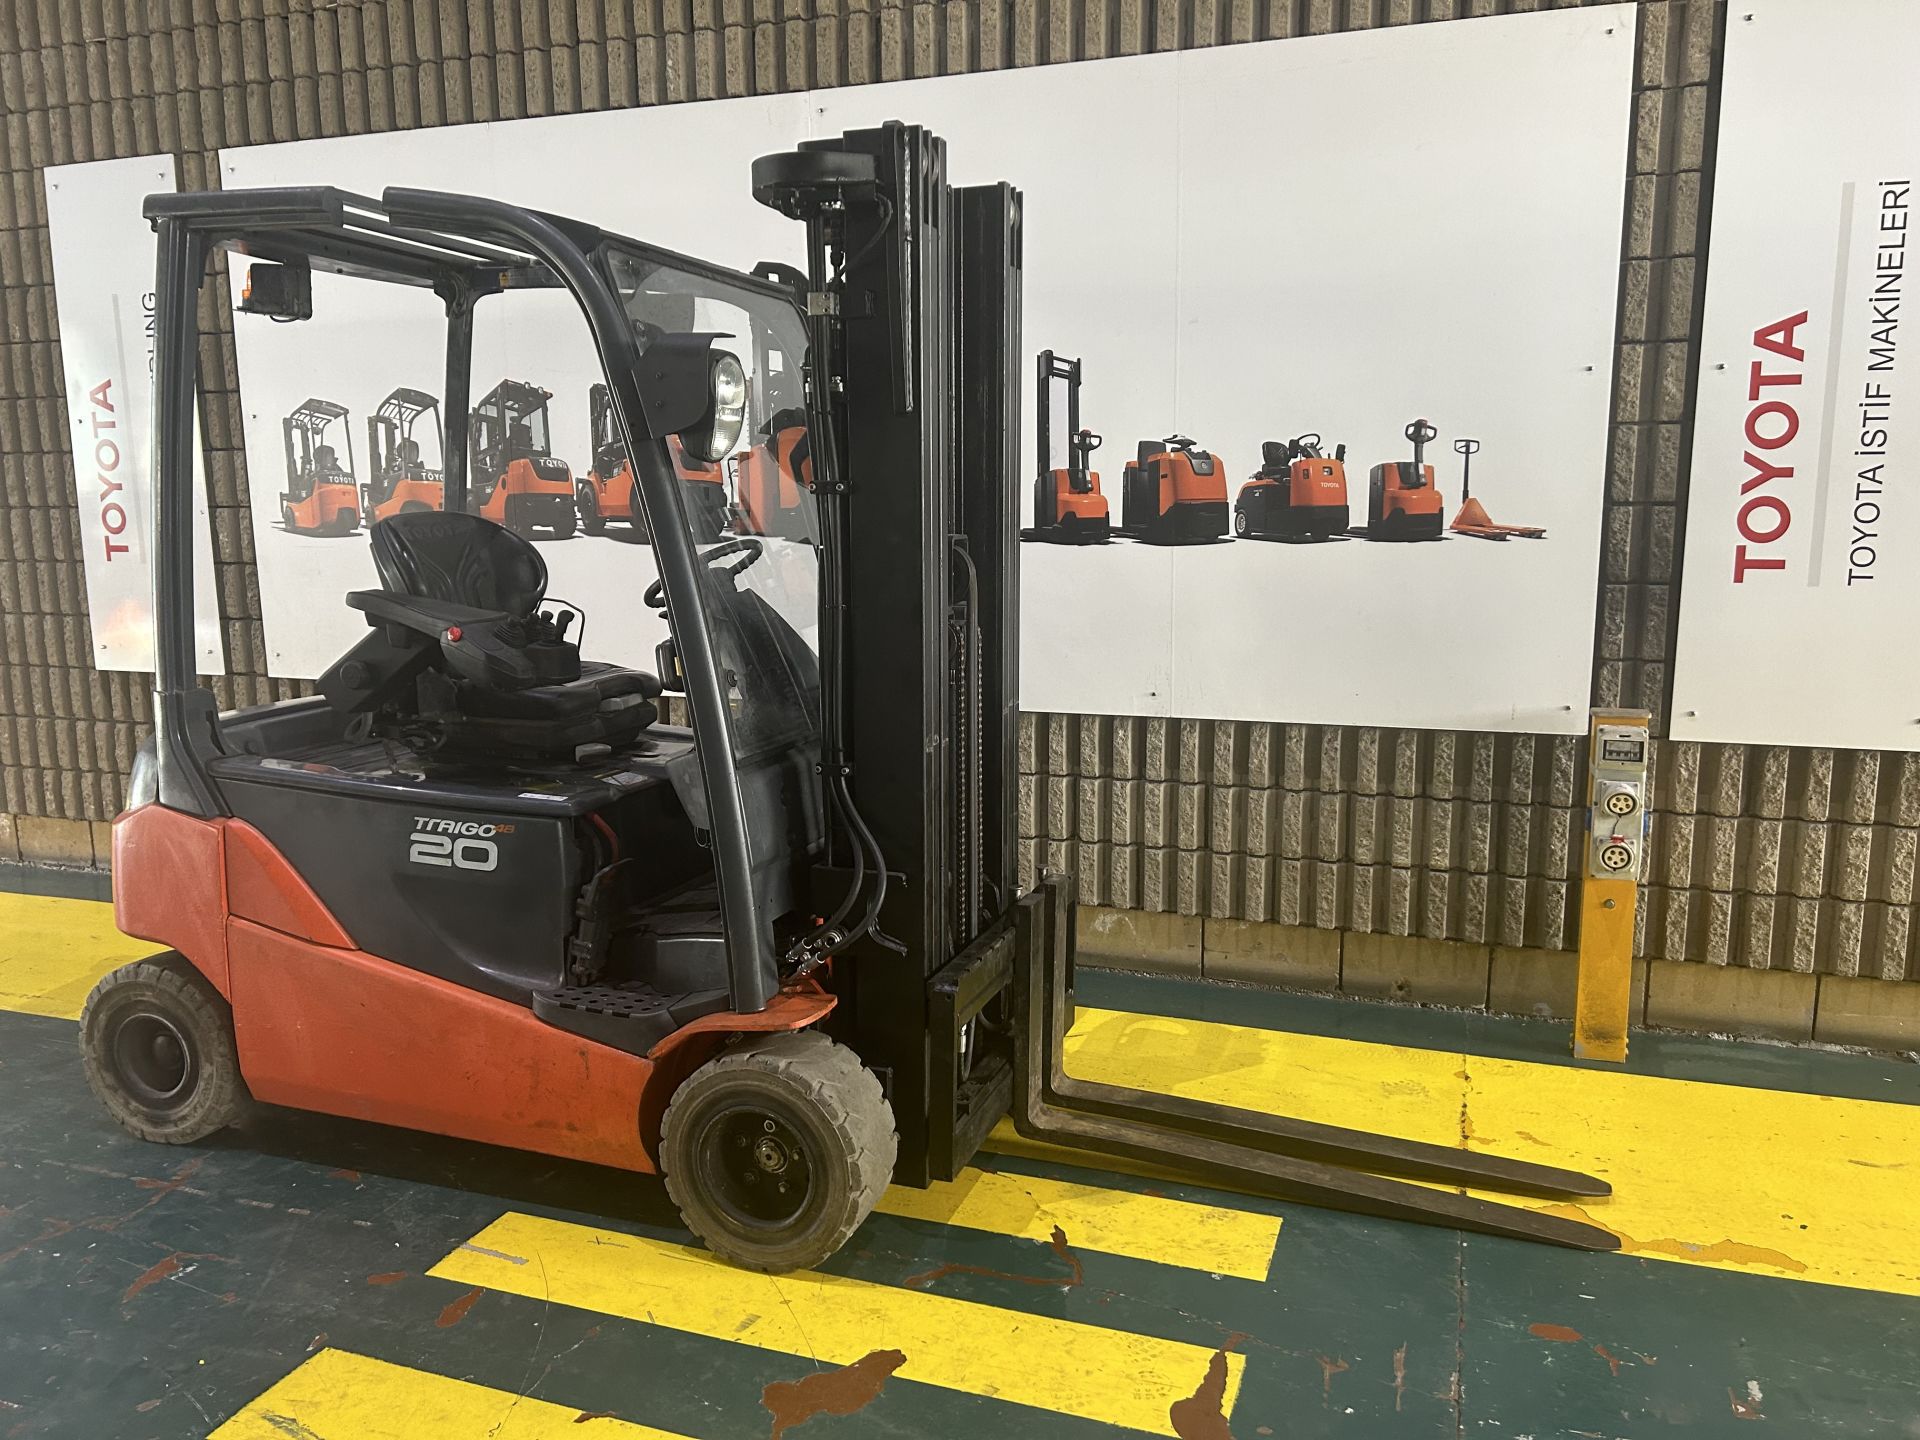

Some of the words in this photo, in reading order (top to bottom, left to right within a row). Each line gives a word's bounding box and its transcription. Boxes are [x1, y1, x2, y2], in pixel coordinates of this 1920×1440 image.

[1867, 180, 1911, 371] MAKİNELERİ
[90, 378, 129, 562] TOYOTA
[1733, 311, 1809, 584] TOYOTA
[1855, 382, 1892, 456] İSTİF
[1848, 463, 1886, 586] TOYOTA
[409, 832, 498, 872] 20
